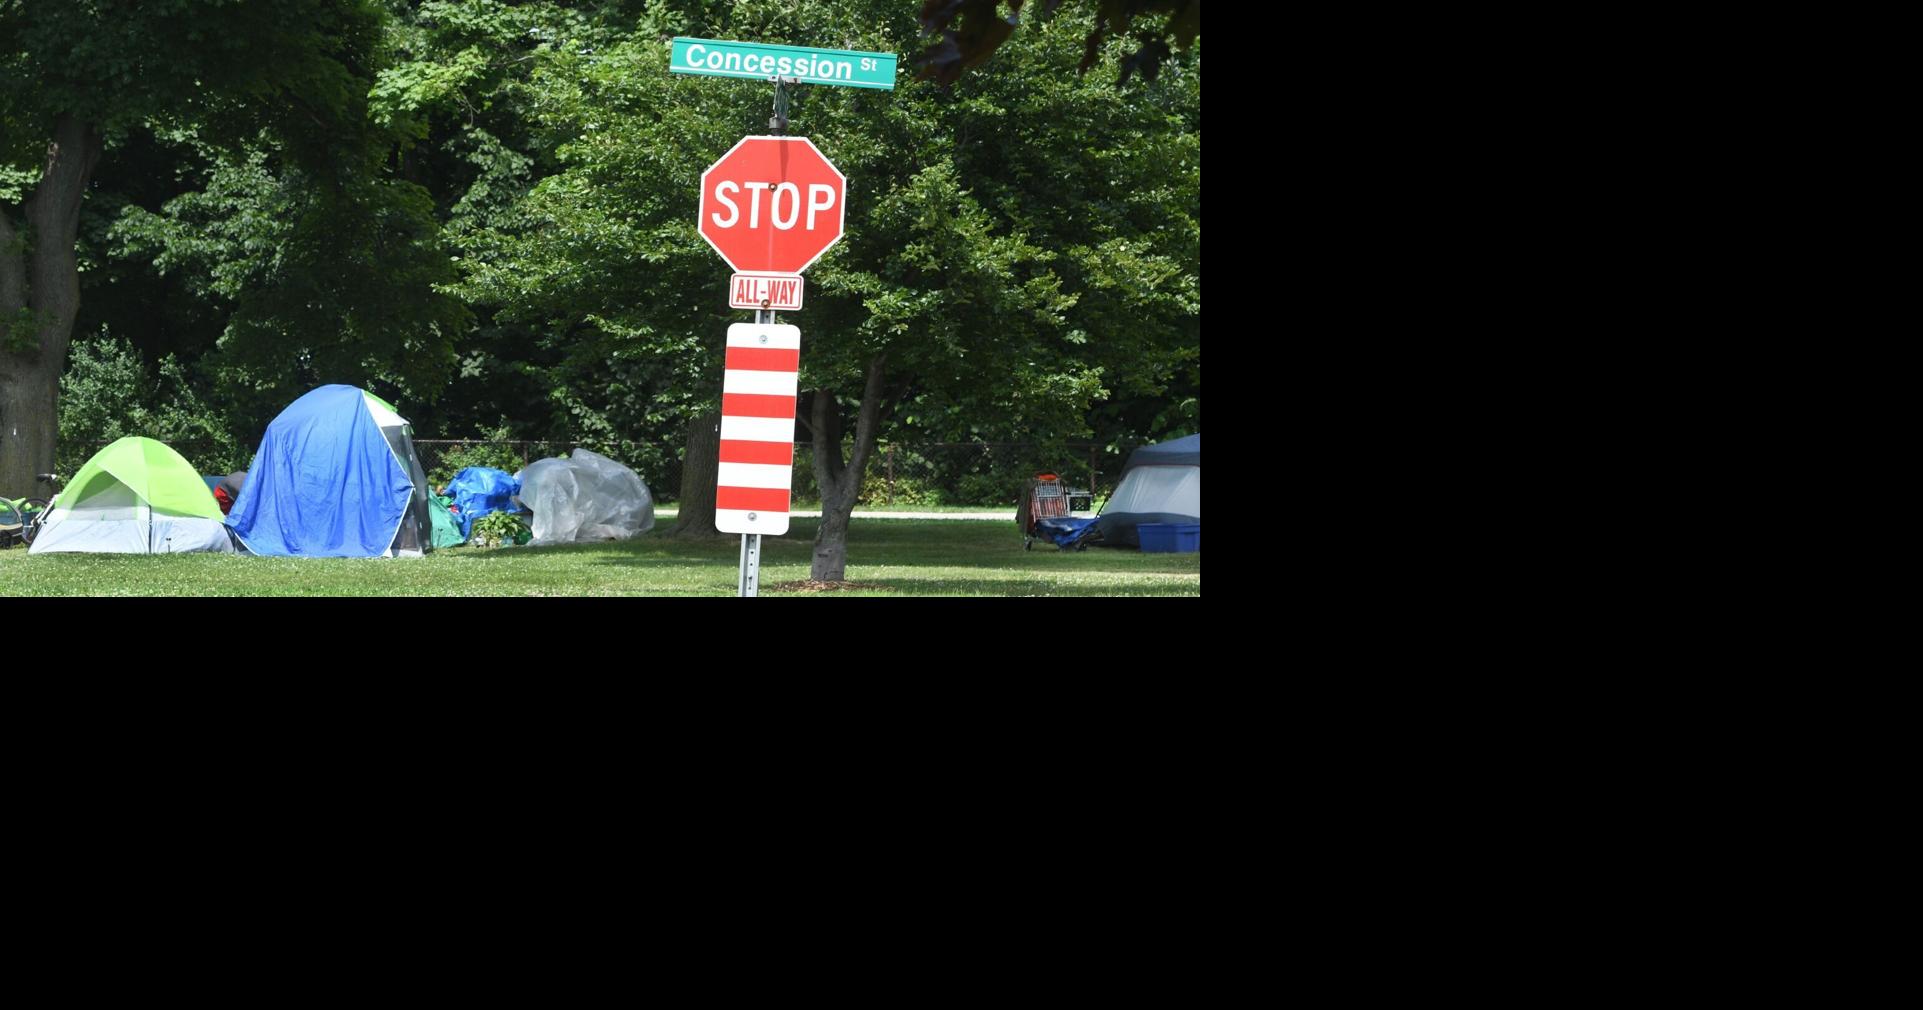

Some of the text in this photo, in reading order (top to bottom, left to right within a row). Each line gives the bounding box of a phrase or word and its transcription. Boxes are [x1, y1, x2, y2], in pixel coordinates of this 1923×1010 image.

[685, 43, 878, 79] Concession St
[711, 180, 836, 230] STOP
[736, 279, 797, 305] ALL-WAY
